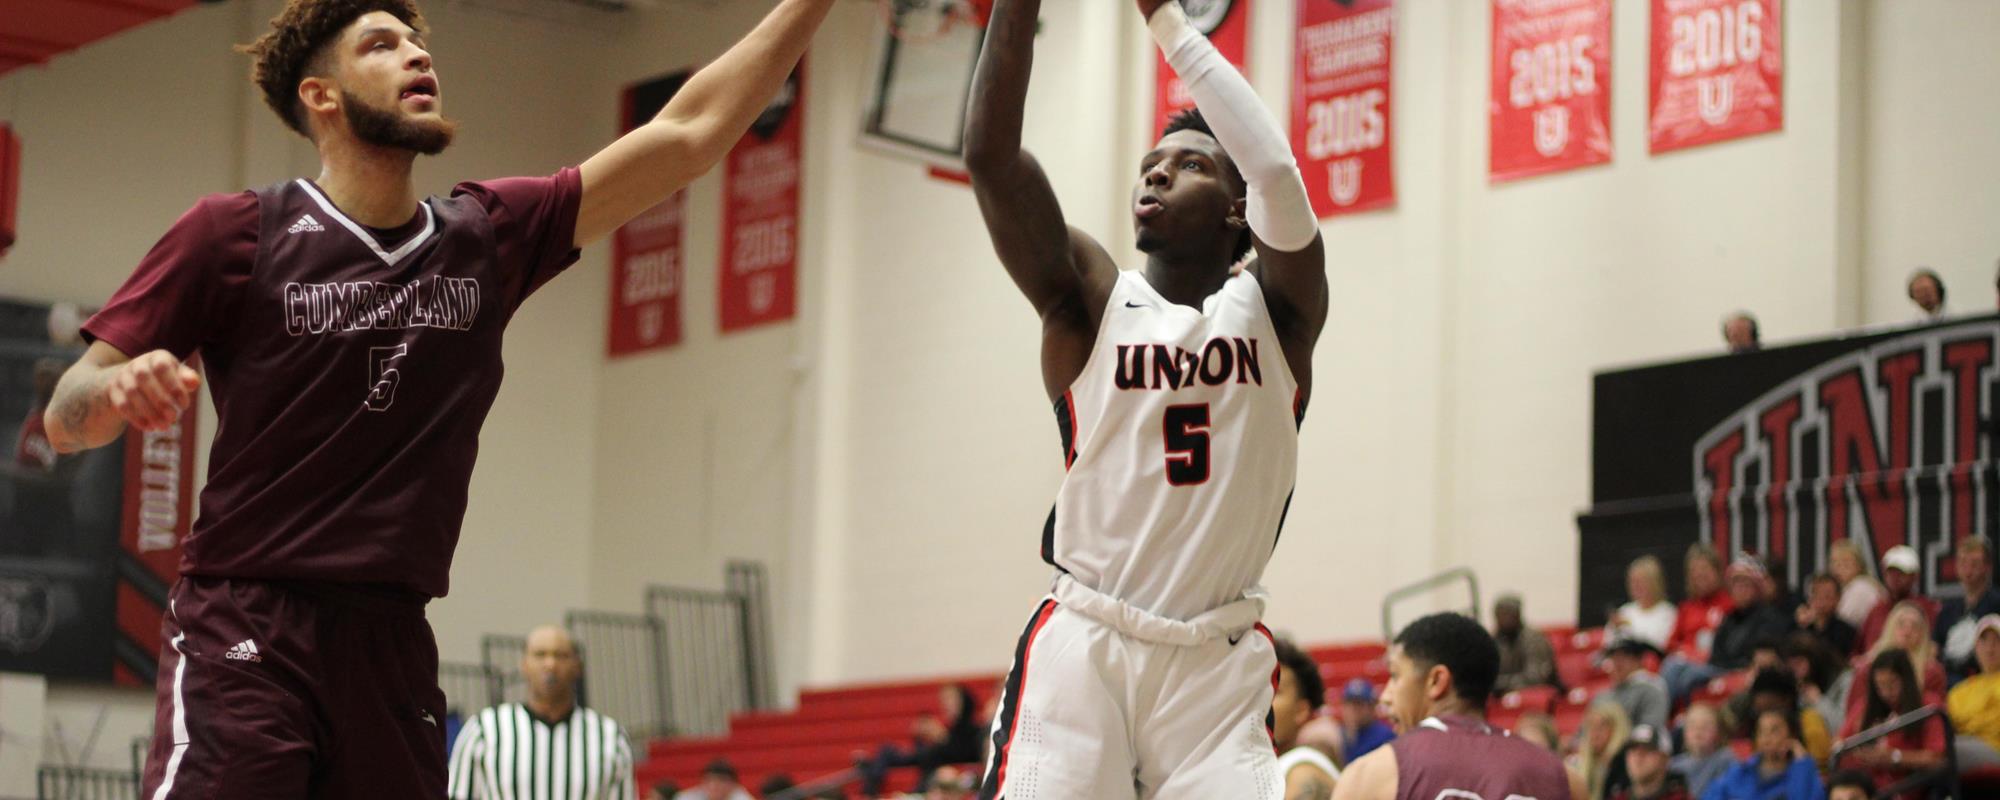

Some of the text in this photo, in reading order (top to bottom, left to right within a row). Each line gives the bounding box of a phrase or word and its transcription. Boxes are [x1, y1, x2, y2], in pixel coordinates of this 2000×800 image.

[1669, 0, 1763, 77] 2016
[1509, 34, 1597, 109] 2015
[1697, 74, 1735, 125] U
[1306, 88, 1386, 160] 2015
[1533, 106, 1569, 157] U
[1326, 158, 1363, 206] U
[288, 221, 325, 234] adidas
[284, 274, 480, 337] CUMBERLAND
[365, 343, 407, 412] 5
[1114, 336, 1262, 391] UNION
[1162, 402, 1211, 487] 5
[225, 650, 263, 663] adidas
